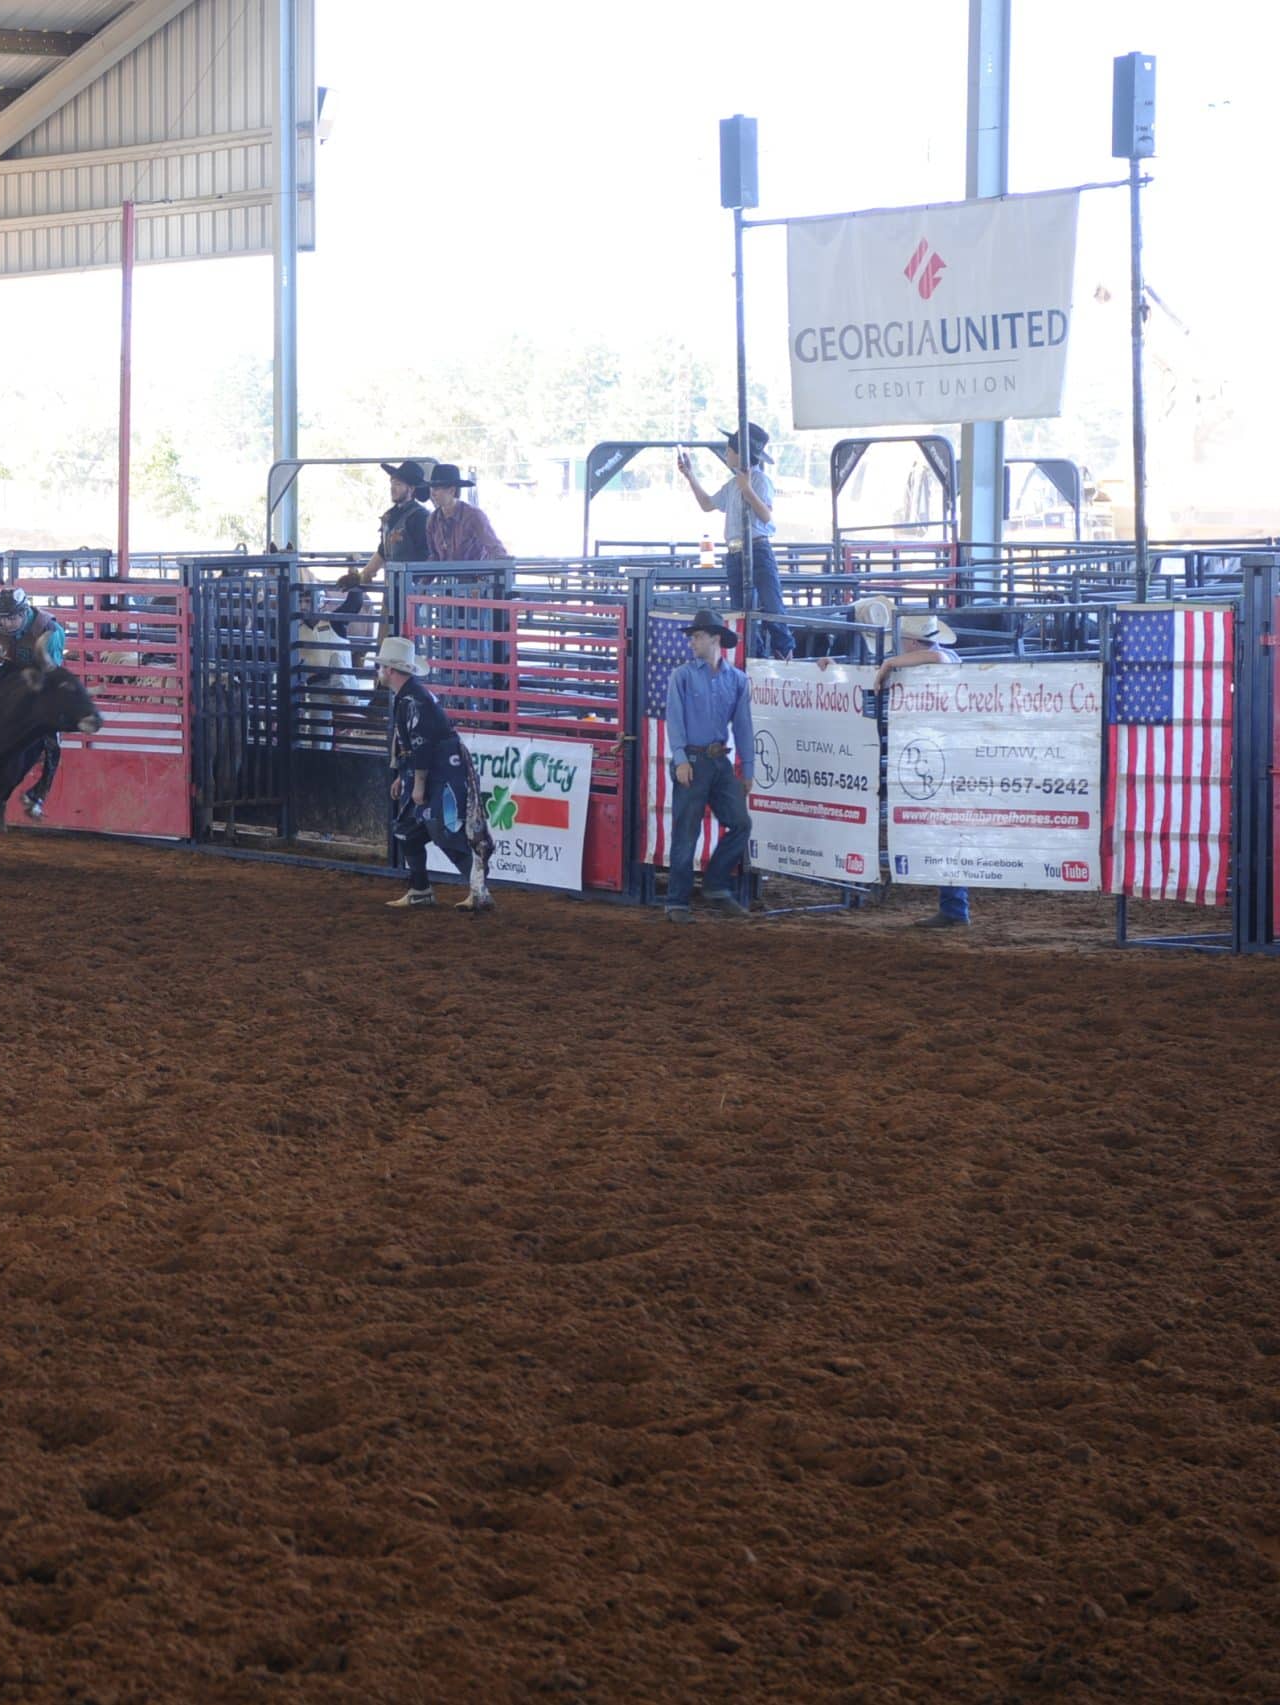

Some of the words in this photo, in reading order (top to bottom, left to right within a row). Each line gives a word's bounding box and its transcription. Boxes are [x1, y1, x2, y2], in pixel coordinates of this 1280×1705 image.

[855, 381, 925, 400] CREDIT
[939, 375, 1017, 396] UNION
[782, 680, 813, 709] Creek
[816, 683, 849, 713] Rodeo
[890, 683, 949, 712] Double
[955, 683, 1004, 713] Creek
[1010, 683, 1064, 713] Rodeo
[1070, 682, 1099, 713] Co.
[796, 739, 835, 755] EUTAW,
[839, 744, 853, 756] AL
[975, 746, 1038, 760] EUTAW,
[1045, 747, 1065, 760] AL
[524, 751, 578, 793] City
[784, 767, 811, 788] (205)
[814, 771, 868, 791] 657-5242
[951, 776, 994, 796] (205)
[1000, 777, 1089, 796] 657-5242
[515, 838, 561, 862] SUPPLY
[496, 858, 527, 873] Georgia
[976, 858, 1024, 868] Facebook
[962, 871, 1003, 880] YouTube
